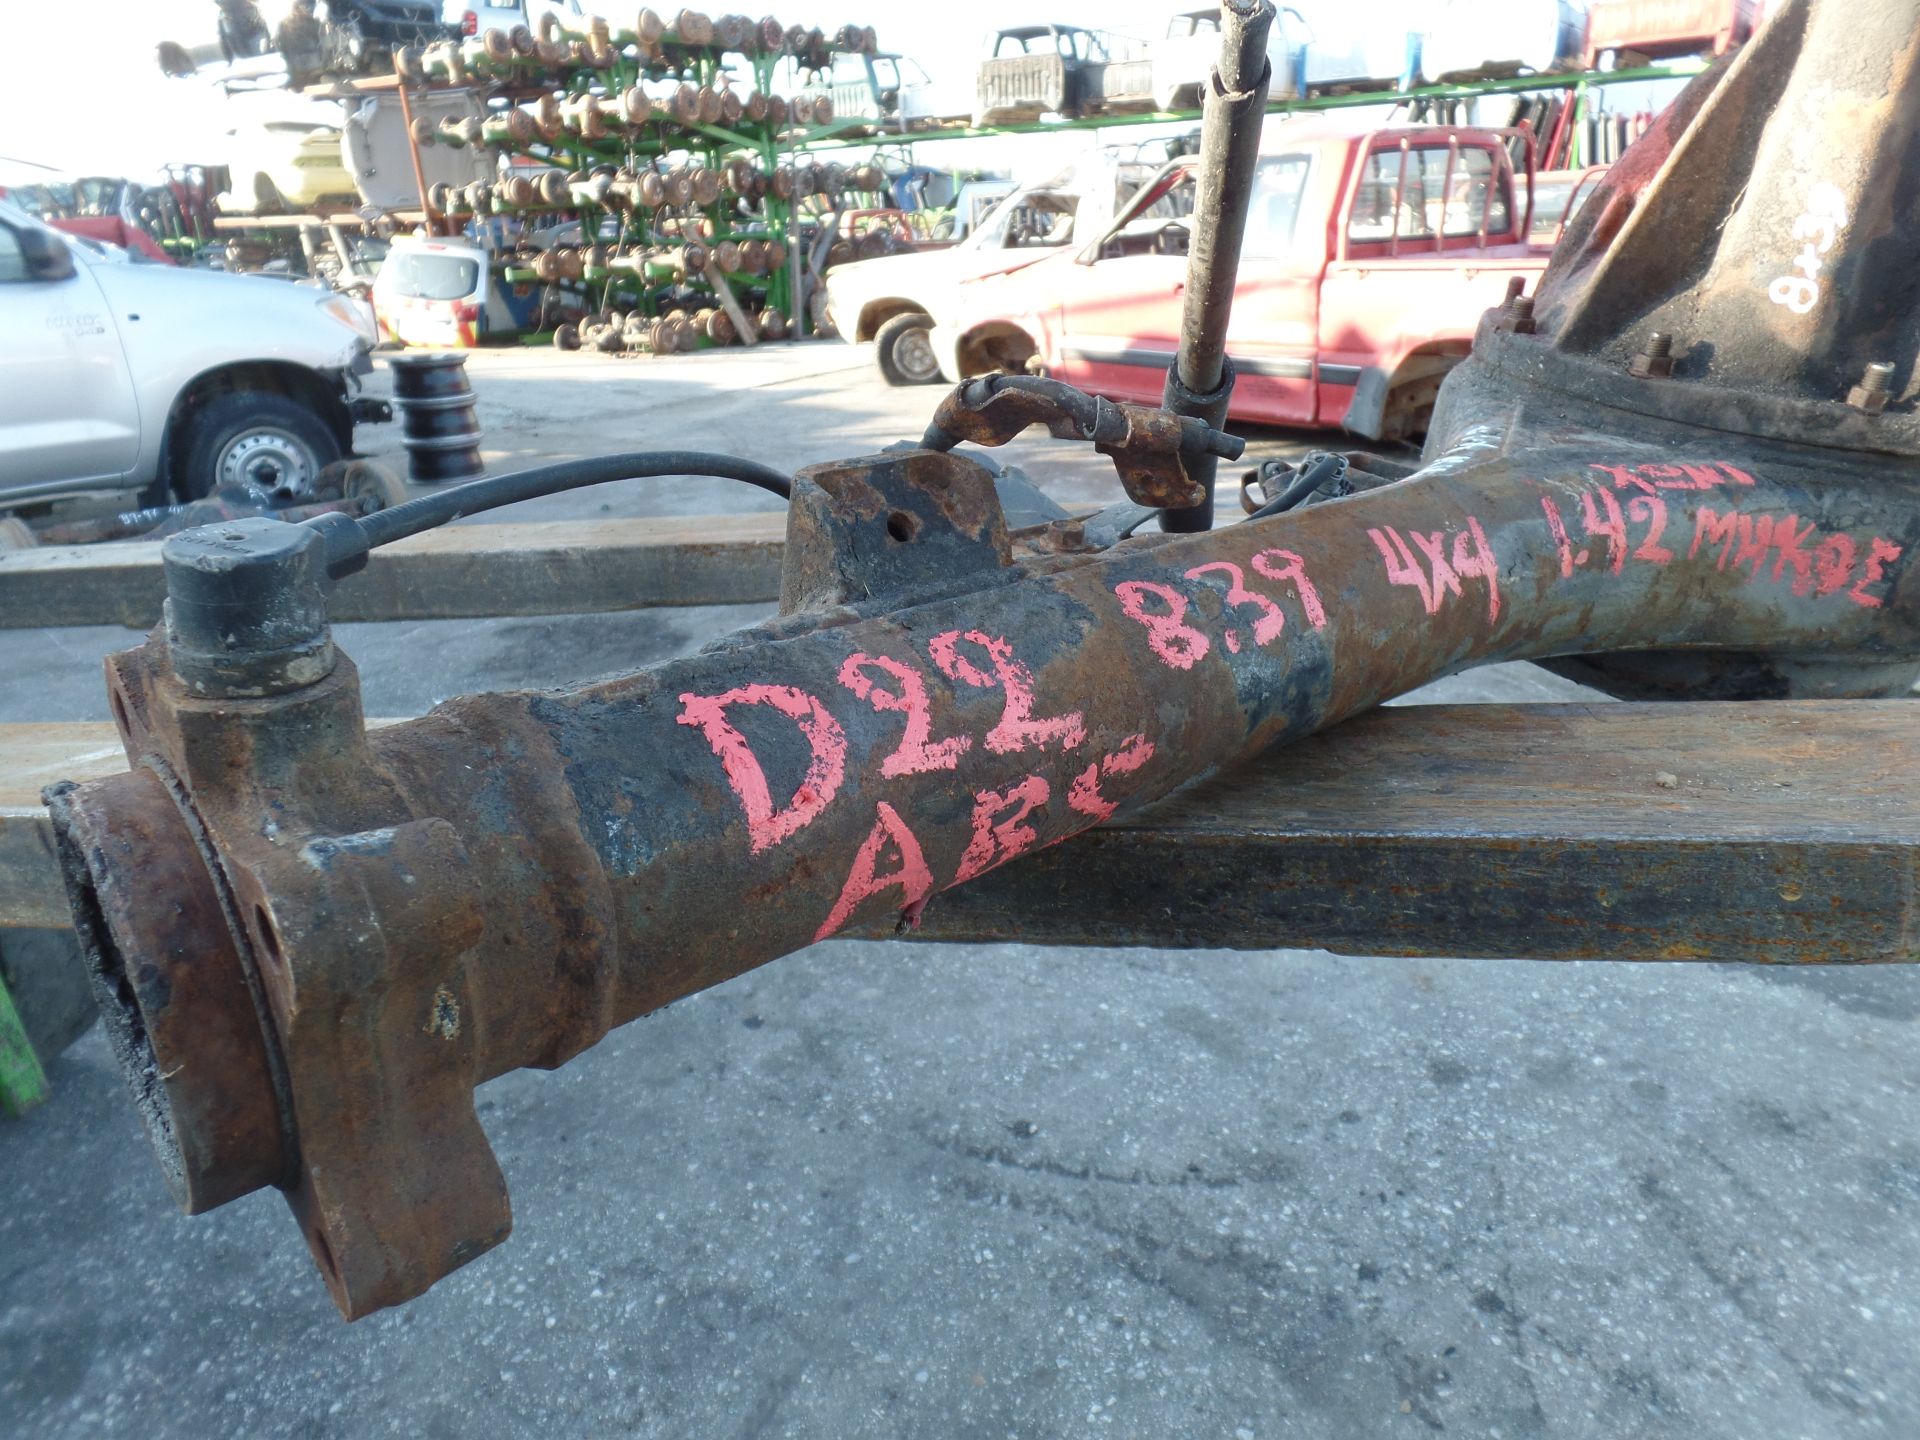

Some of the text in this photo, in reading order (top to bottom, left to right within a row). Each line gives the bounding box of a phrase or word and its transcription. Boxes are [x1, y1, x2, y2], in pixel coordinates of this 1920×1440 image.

[676, 629, 1086, 856] D22
[1114, 547, 1328, 671] 8.39
[1540, 485, 1674, 579] 1.42
